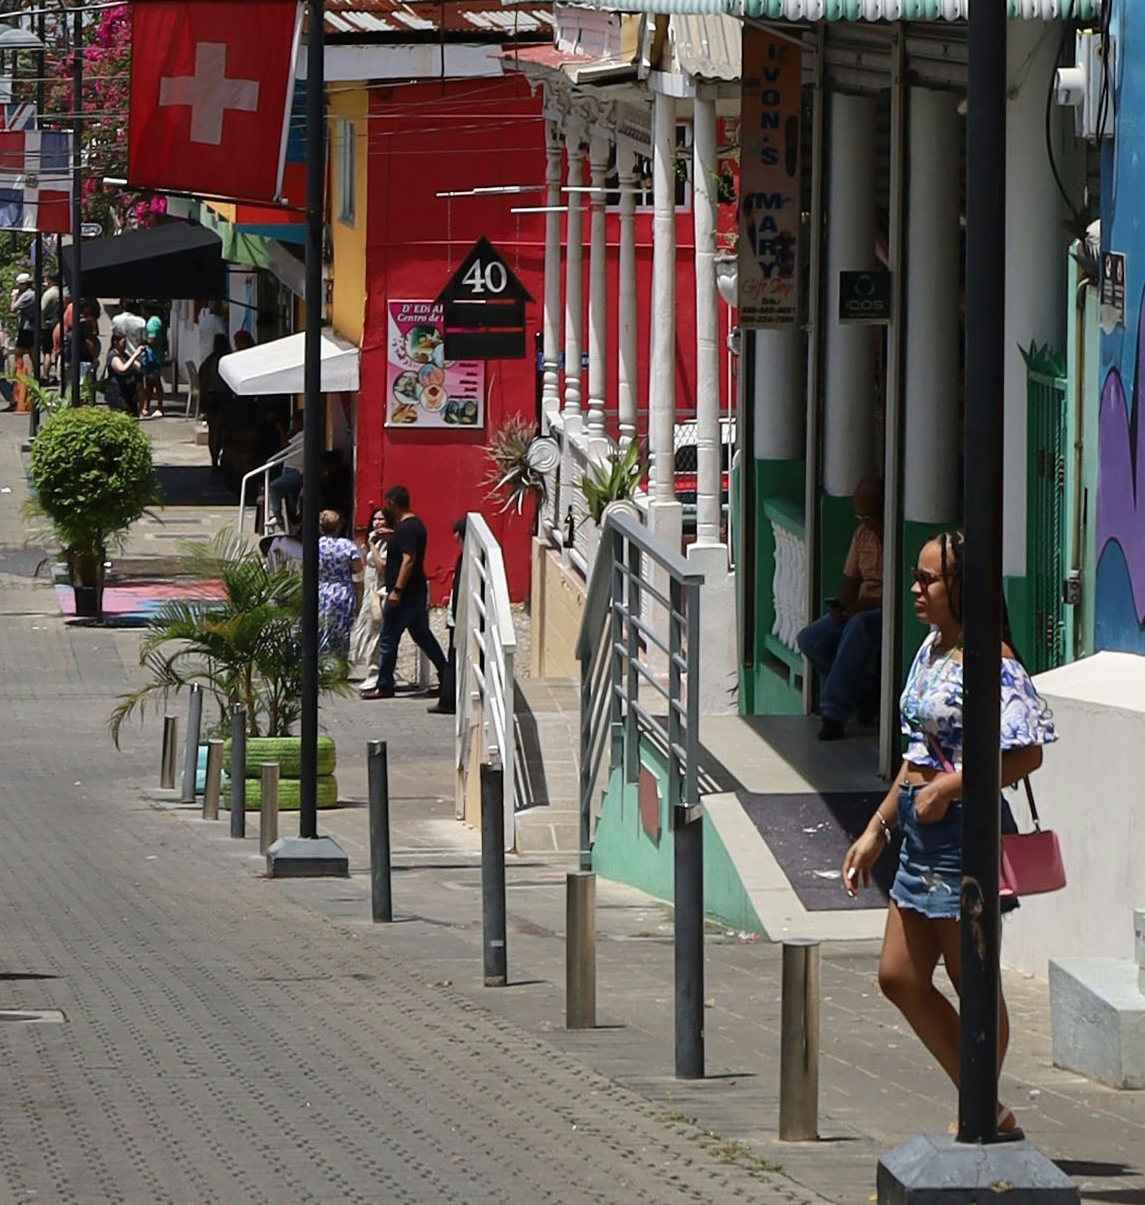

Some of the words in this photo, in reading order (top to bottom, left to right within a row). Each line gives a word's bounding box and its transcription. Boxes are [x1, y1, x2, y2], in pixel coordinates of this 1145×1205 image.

[760, 44, 781, 166] IVON'S
[755, 192, 782, 279] MARY
[461, 258, 508, 294] 40
[397, 313, 427, 322] Centro
[428, 313, 440, 322] de
